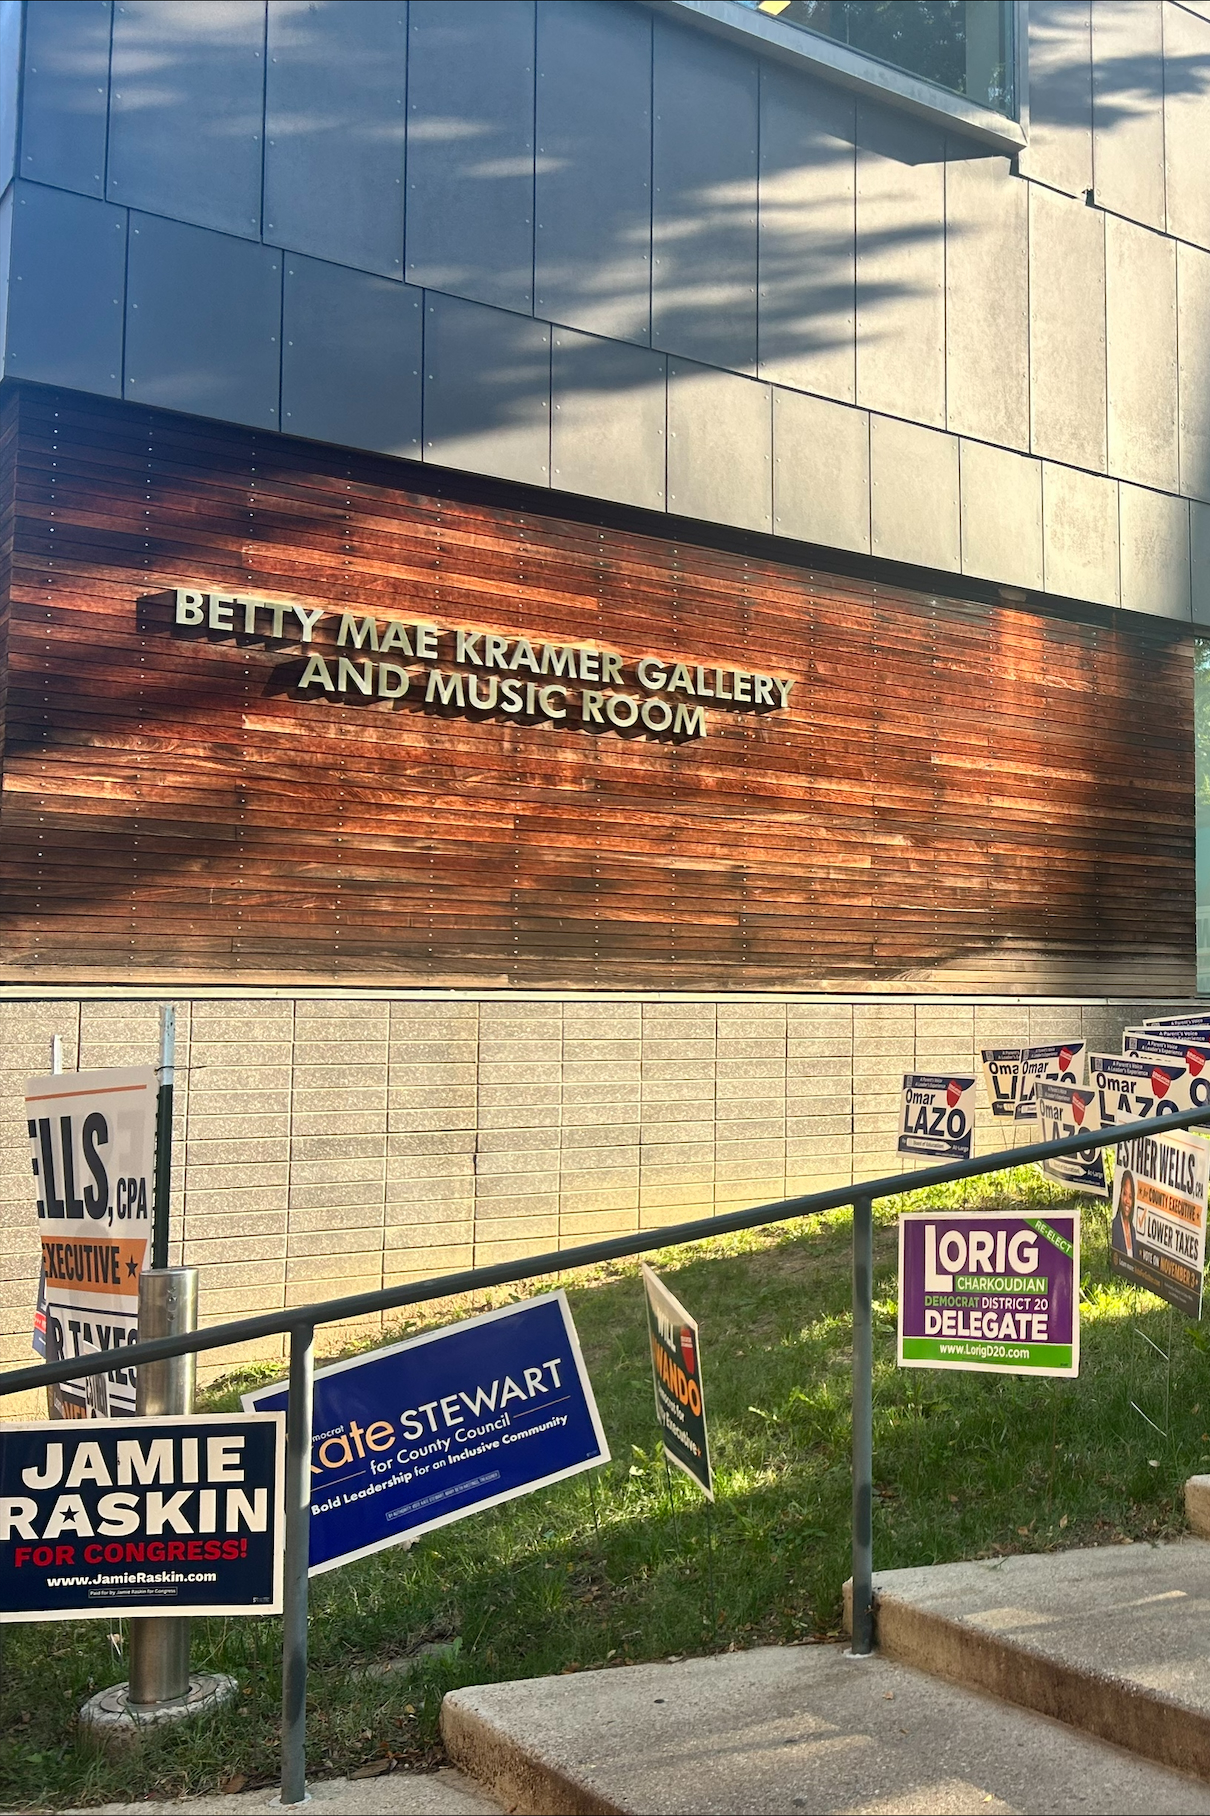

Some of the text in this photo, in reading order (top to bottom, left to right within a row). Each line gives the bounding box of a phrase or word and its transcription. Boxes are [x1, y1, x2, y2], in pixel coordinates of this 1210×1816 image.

[175, 589, 795, 708] BETTY MAE KRAMER GALLERY
[299, 655, 707, 738] AND MUSIC ROOM
[1022, 1060, 1049, 1075] Omar
[1162, 1048, 1183, 1056] Experience
[906, 1088, 936, 1105] Omar
[1096, 1073, 1137, 1094] Omar
[904, 1105, 966, 1139] LAZO
[1040, 1099, 1063, 1121] Omar
[1116, 1136, 1196, 1199] ESTHER WELLS,
[116, 1177, 148, 1219] CPA
[1148, 1187, 1196, 1222] COUNTY EXECUTIVE
[1034, 1220, 1072, 1254] RE-ELECT
[1147, 1215, 1199, 1262] LOWER TAXES
[924, 1224, 1039, 1292] LORIG
[1160, 1256, 1191, 1286] NOVEMBER
[1190, 1272, 1196, 1288] 3
[957, 1277, 1045, 1292] CHARKOUDIAN
[924, 1295, 1048, 1311] DEMOCRAT DISTRICT 20
[924, 1309, 1048, 1341] DELEGATE
[939, 1343, 1030, 1360] www.LorigD20.com
[400, 1358, 562, 1441] STEWART
[370, 1411, 511, 1476] for County Council
[21, 1436, 246, 1490] JAMIE
[311, 1494, 342, 1517] Bold
[343, 1470, 413, 1505] Leadership
[414, 1463, 430, 1478] for
[432, 1459, 447, 1471] an
[448, 1439, 500, 1466] Inclusive
[501, 1414, 568, 1446] Community
[0, 1487, 268, 1541] RASKIN
[14, 1538, 248, 1568] FOR CONGRESS!
[46, 1570, 217, 1587] www.JamieRaskin.com
